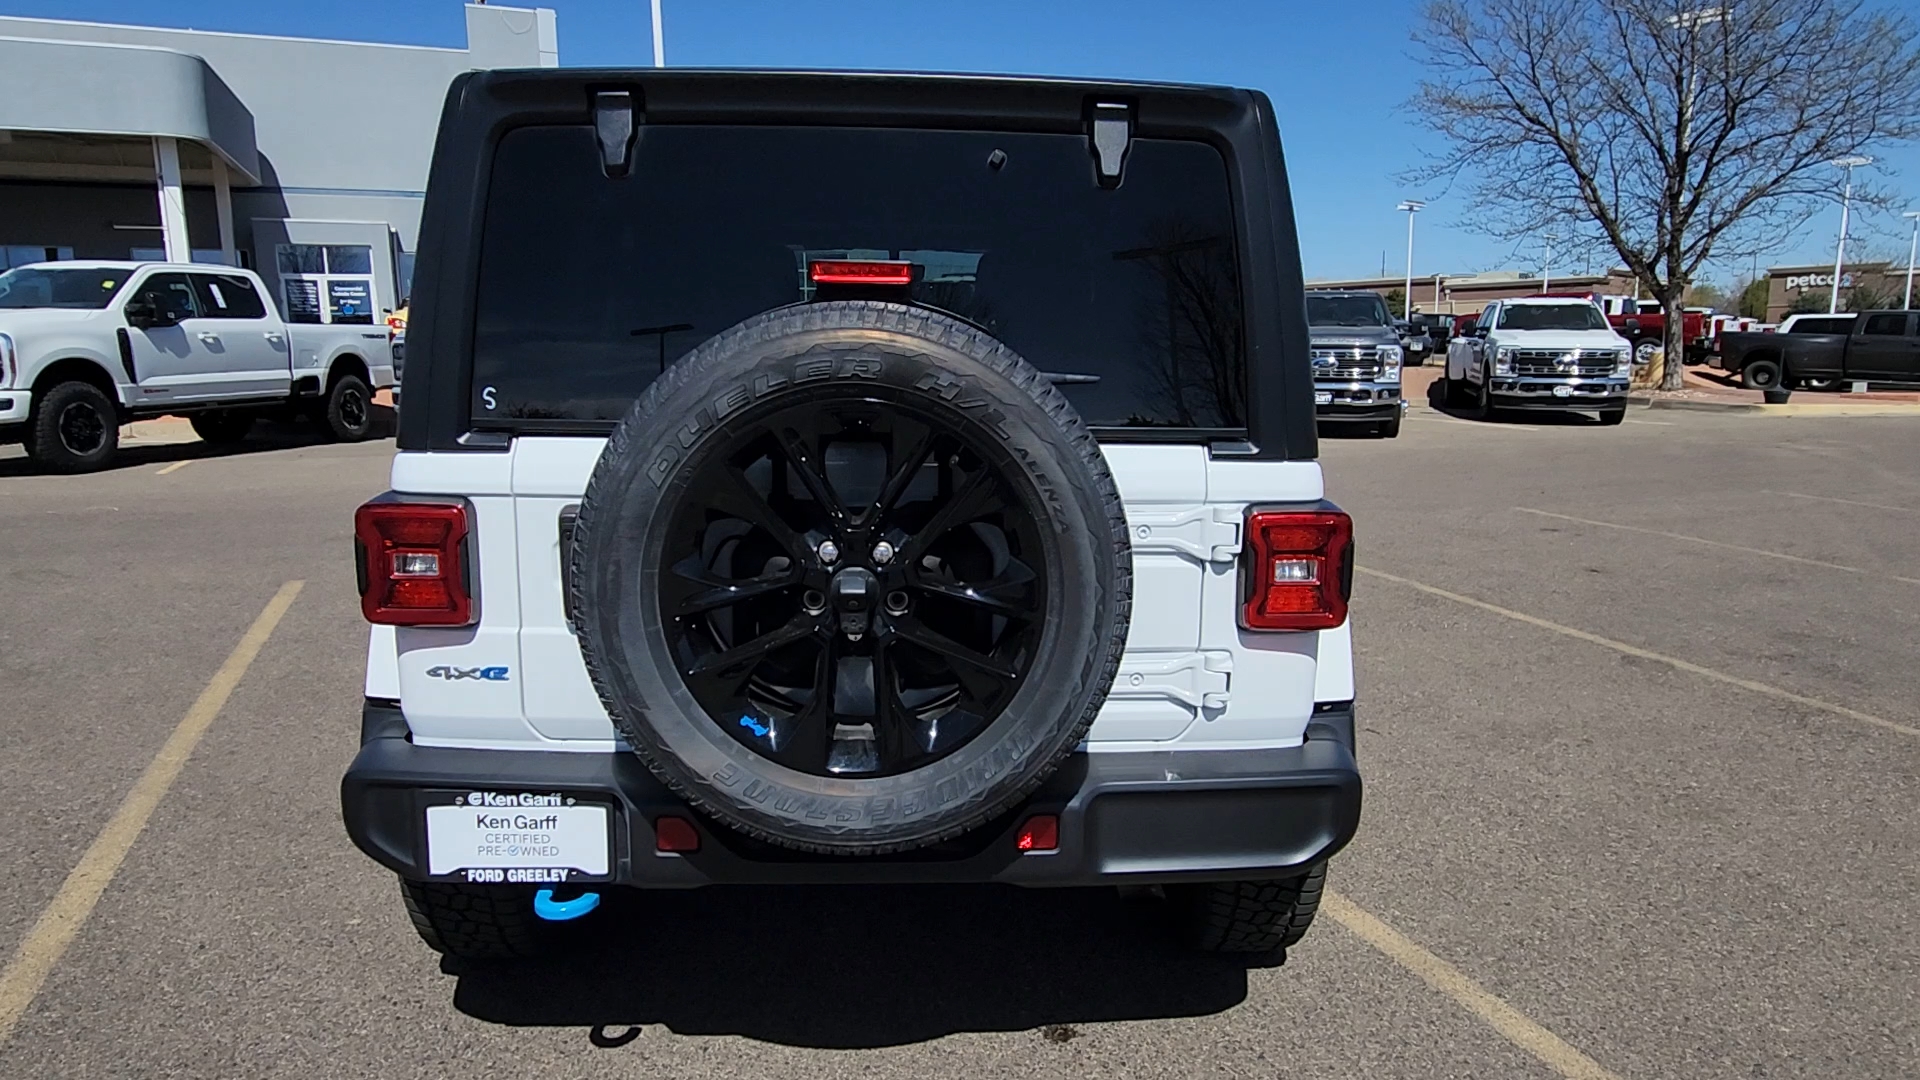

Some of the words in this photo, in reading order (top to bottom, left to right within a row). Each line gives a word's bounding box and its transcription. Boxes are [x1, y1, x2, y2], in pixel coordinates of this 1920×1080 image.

[1785, 273, 1836, 290] petco
[646, 355, 884, 489] DUELER
[1014, 445, 1071, 535] ALENZA
[476, 814, 511, 829] Ken
[514, 814, 558, 830] Garff
[485, 833, 551, 844] CERTIFIED
[467, 869, 505, 882] FORD
[507, 868, 568, 882] GREELEY
